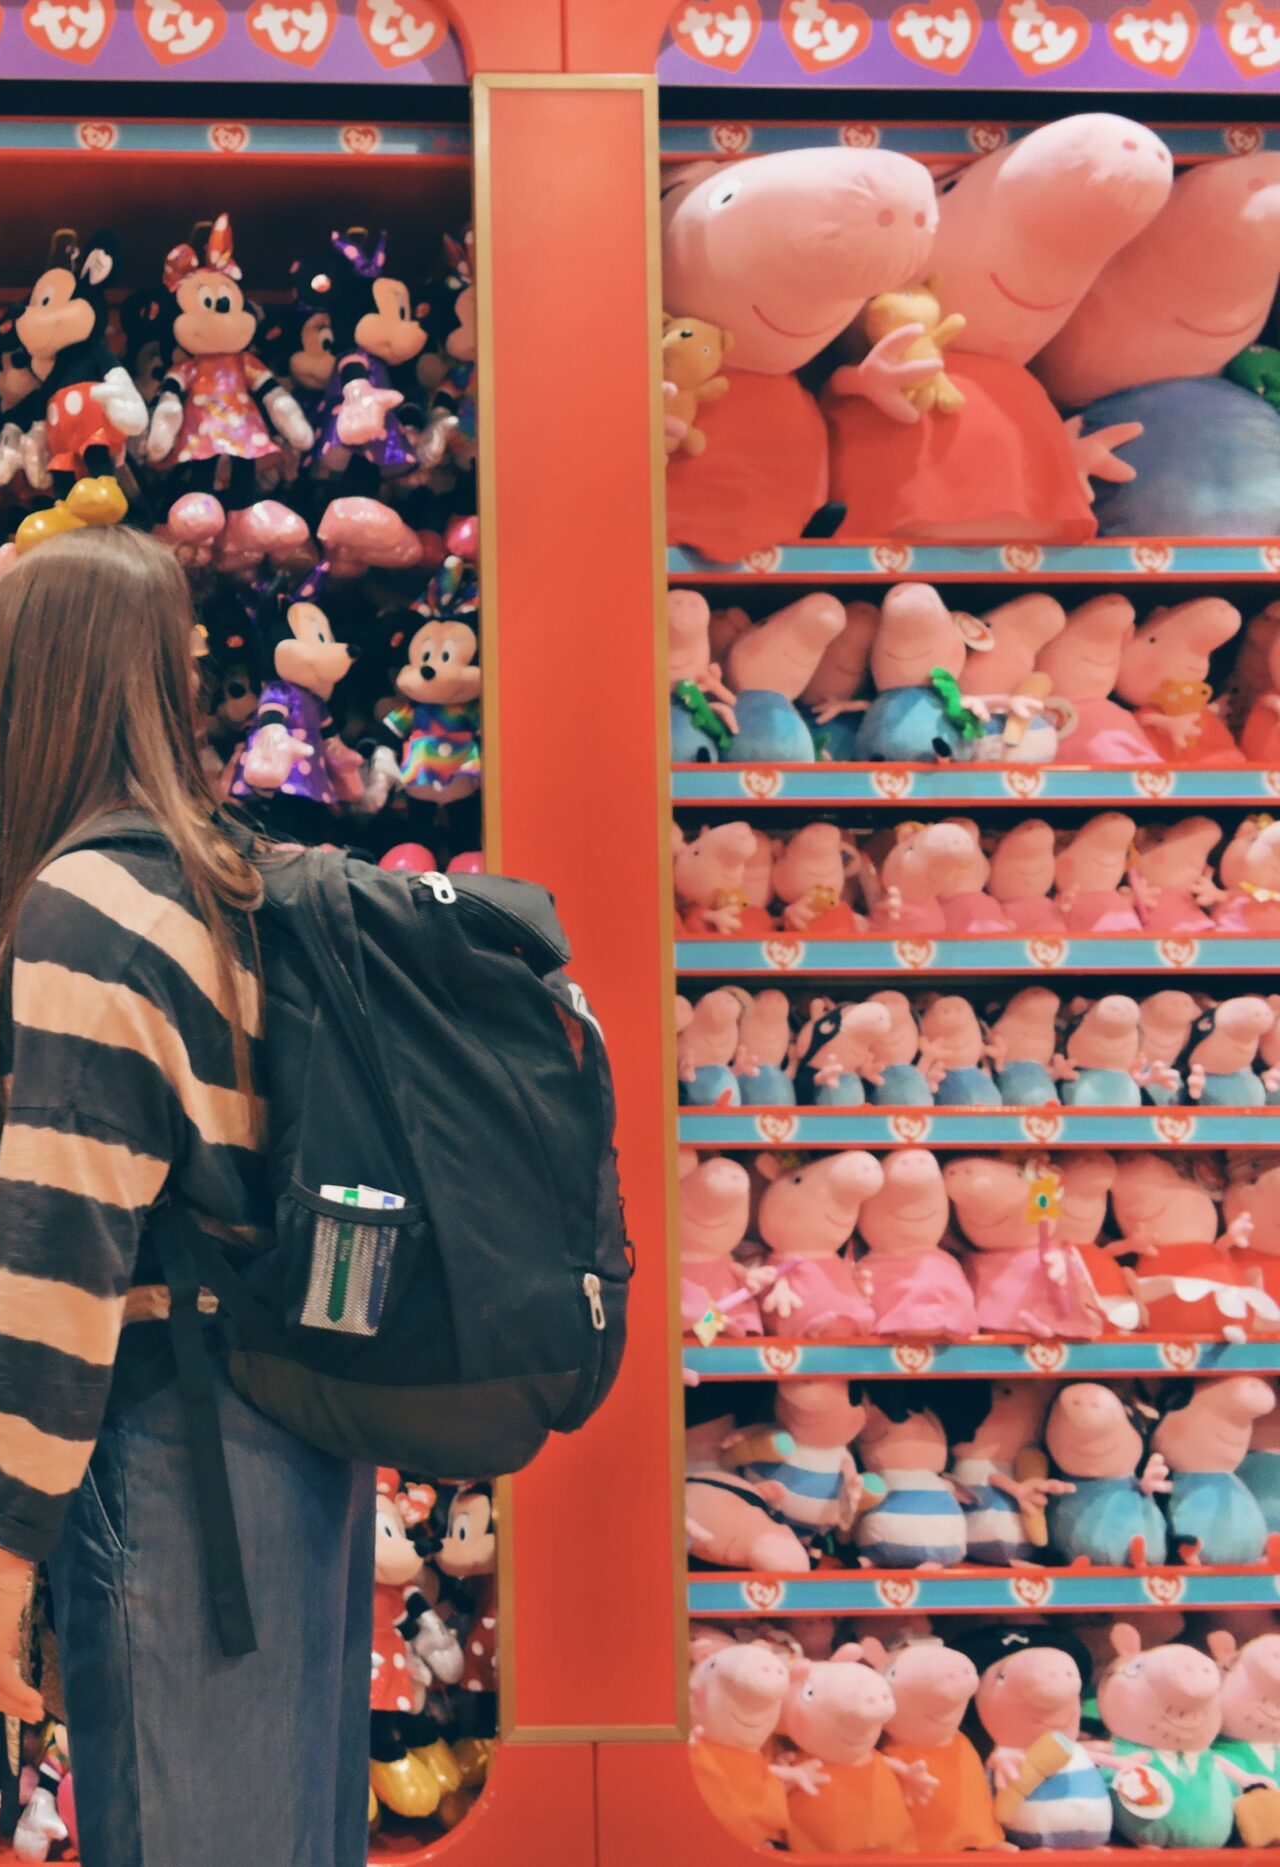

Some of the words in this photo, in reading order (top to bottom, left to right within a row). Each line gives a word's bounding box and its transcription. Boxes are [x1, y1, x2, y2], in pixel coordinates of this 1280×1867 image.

[29, 0, 106, 50] ty
[145, 0, 214, 54] ty
[252, 1, 328, 52] ty
[366, 0, 435, 57] ty
[677, 5, 751, 58] ty
[789, 0, 859, 61] ty
[896, 7, 971, 59] ty
[1009, 0, 1078, 64] ty
[1114, 11, 1189, 63] ty
[1226, 2, 1280, 67] ty
